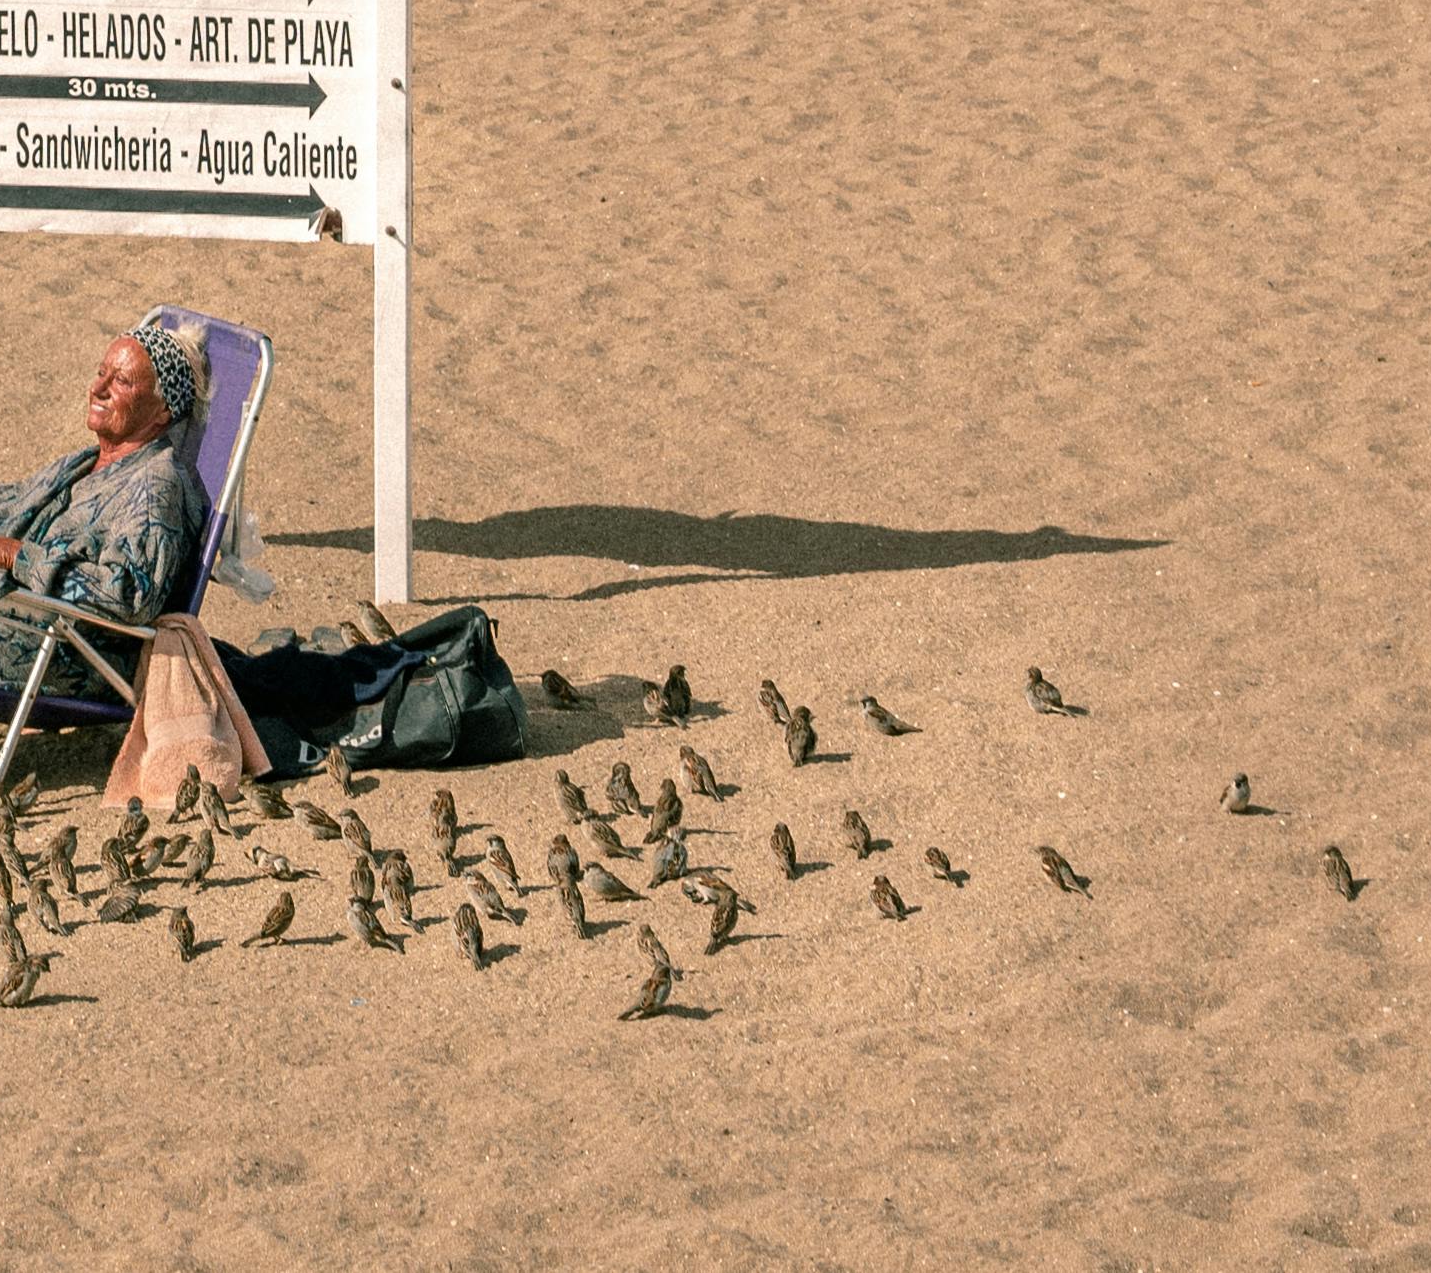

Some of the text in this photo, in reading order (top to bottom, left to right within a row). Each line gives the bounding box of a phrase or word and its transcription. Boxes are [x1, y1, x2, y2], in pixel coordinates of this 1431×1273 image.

[62, 11, 166, 61] HELADOS
[189, 15, 239, 64] ART.
[247, 17, 276, 65] DE
[284, 18, 354, 68] PLAYA
[68, 78, 157, 99] 30 mts.
[16, 121, 172, 173] Sandwicheria
[197, 128, 254, 185] Agua
[263, 130, 358, 180] Caliente
